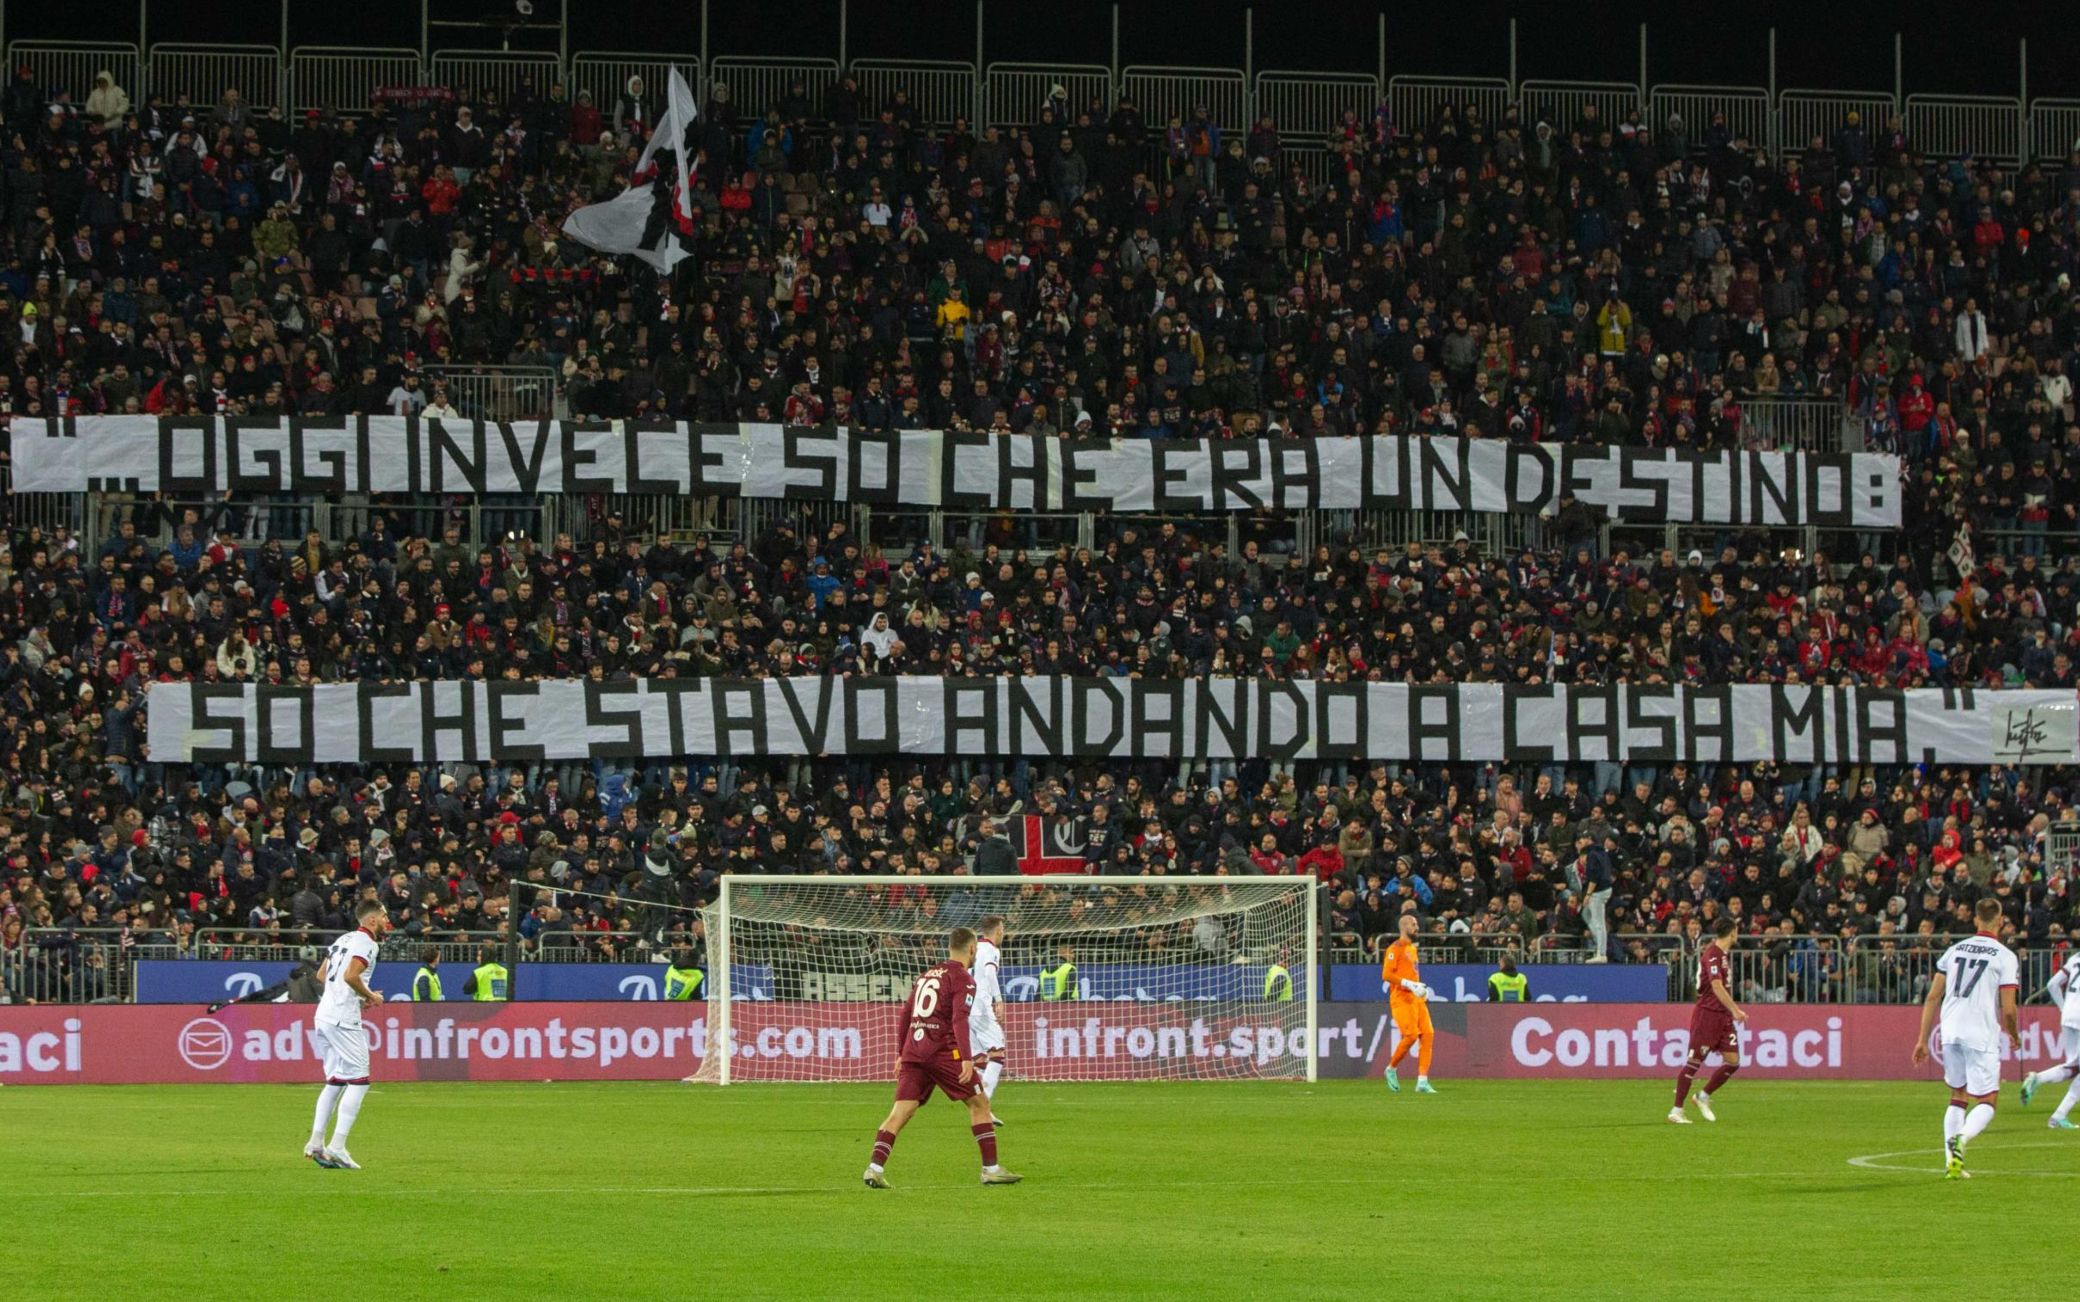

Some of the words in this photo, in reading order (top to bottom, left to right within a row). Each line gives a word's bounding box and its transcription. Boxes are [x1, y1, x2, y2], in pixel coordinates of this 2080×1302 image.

[406, 418, 741, 495] INVECE
[784, 426, 899, 502] SO
[942, 431, 1112, 509] CHE
[1154, 438, 1319, 510] ERA
[1361, 435, 1470, 512] UN
[192, 683, 314, 762] SO
[358, 680, 544, 762] CHE
[586, 677, 898, 756] STAVO
[944, 676, 1367, 758] ANDANDO
[1409, 682, 1460, 760] A
[1504, 682, 1733, 761] CASA
[913, 978, 940, 1018] 16
[1954, 957, 1989, 998] 17
